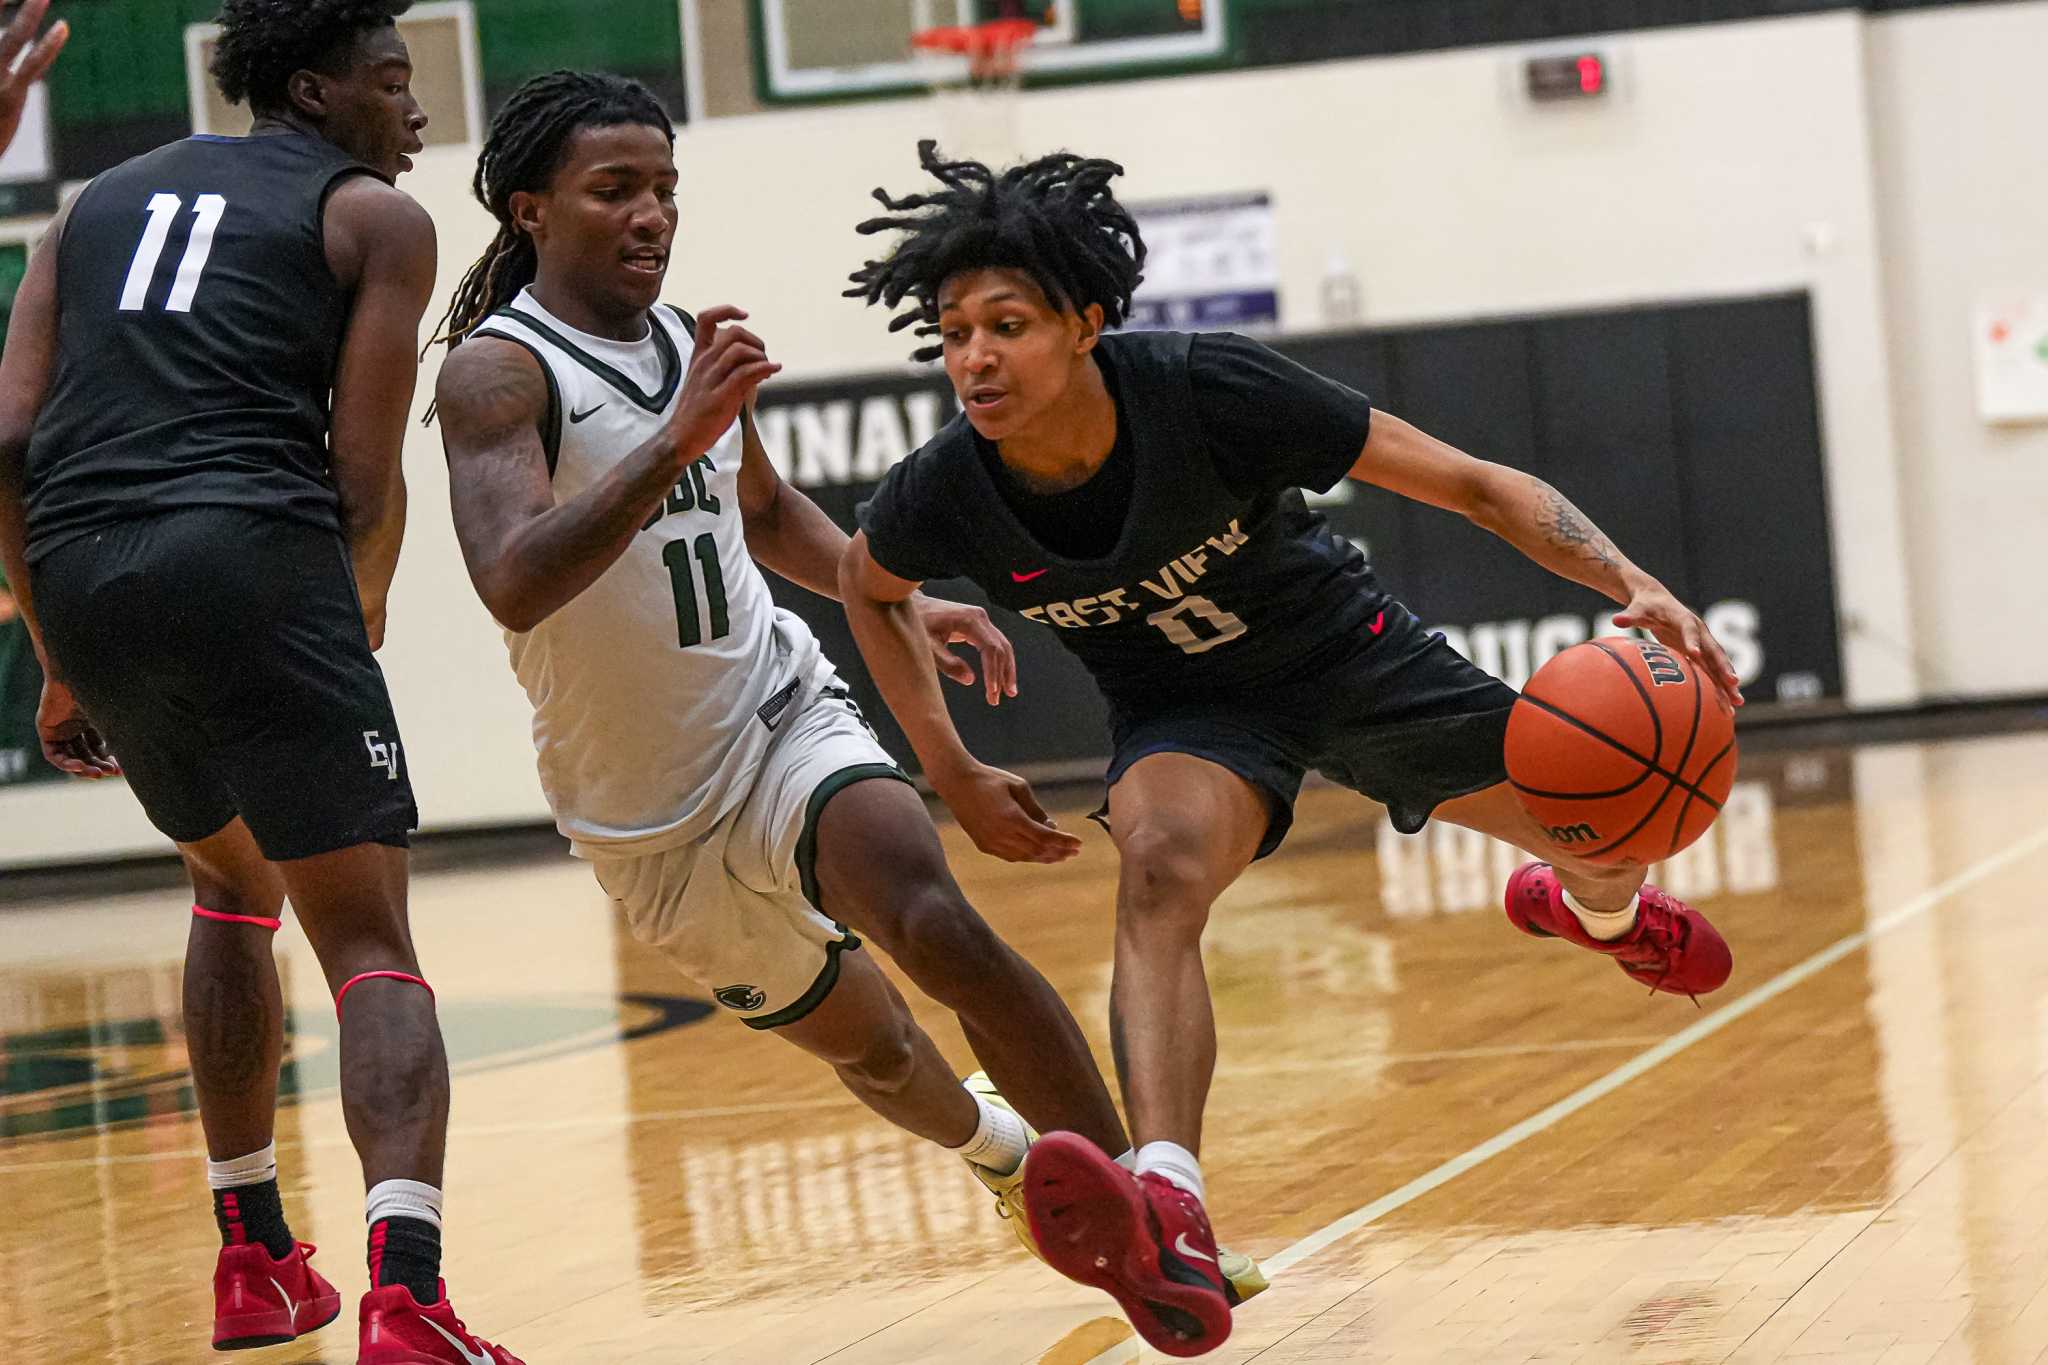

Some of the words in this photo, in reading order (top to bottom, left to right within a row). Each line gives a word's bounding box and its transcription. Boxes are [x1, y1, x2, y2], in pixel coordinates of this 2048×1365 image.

[118, 192, 228, 313] 11
[661, 531, 730, 649] 11
[1146, 595, 1248, 655] 0
